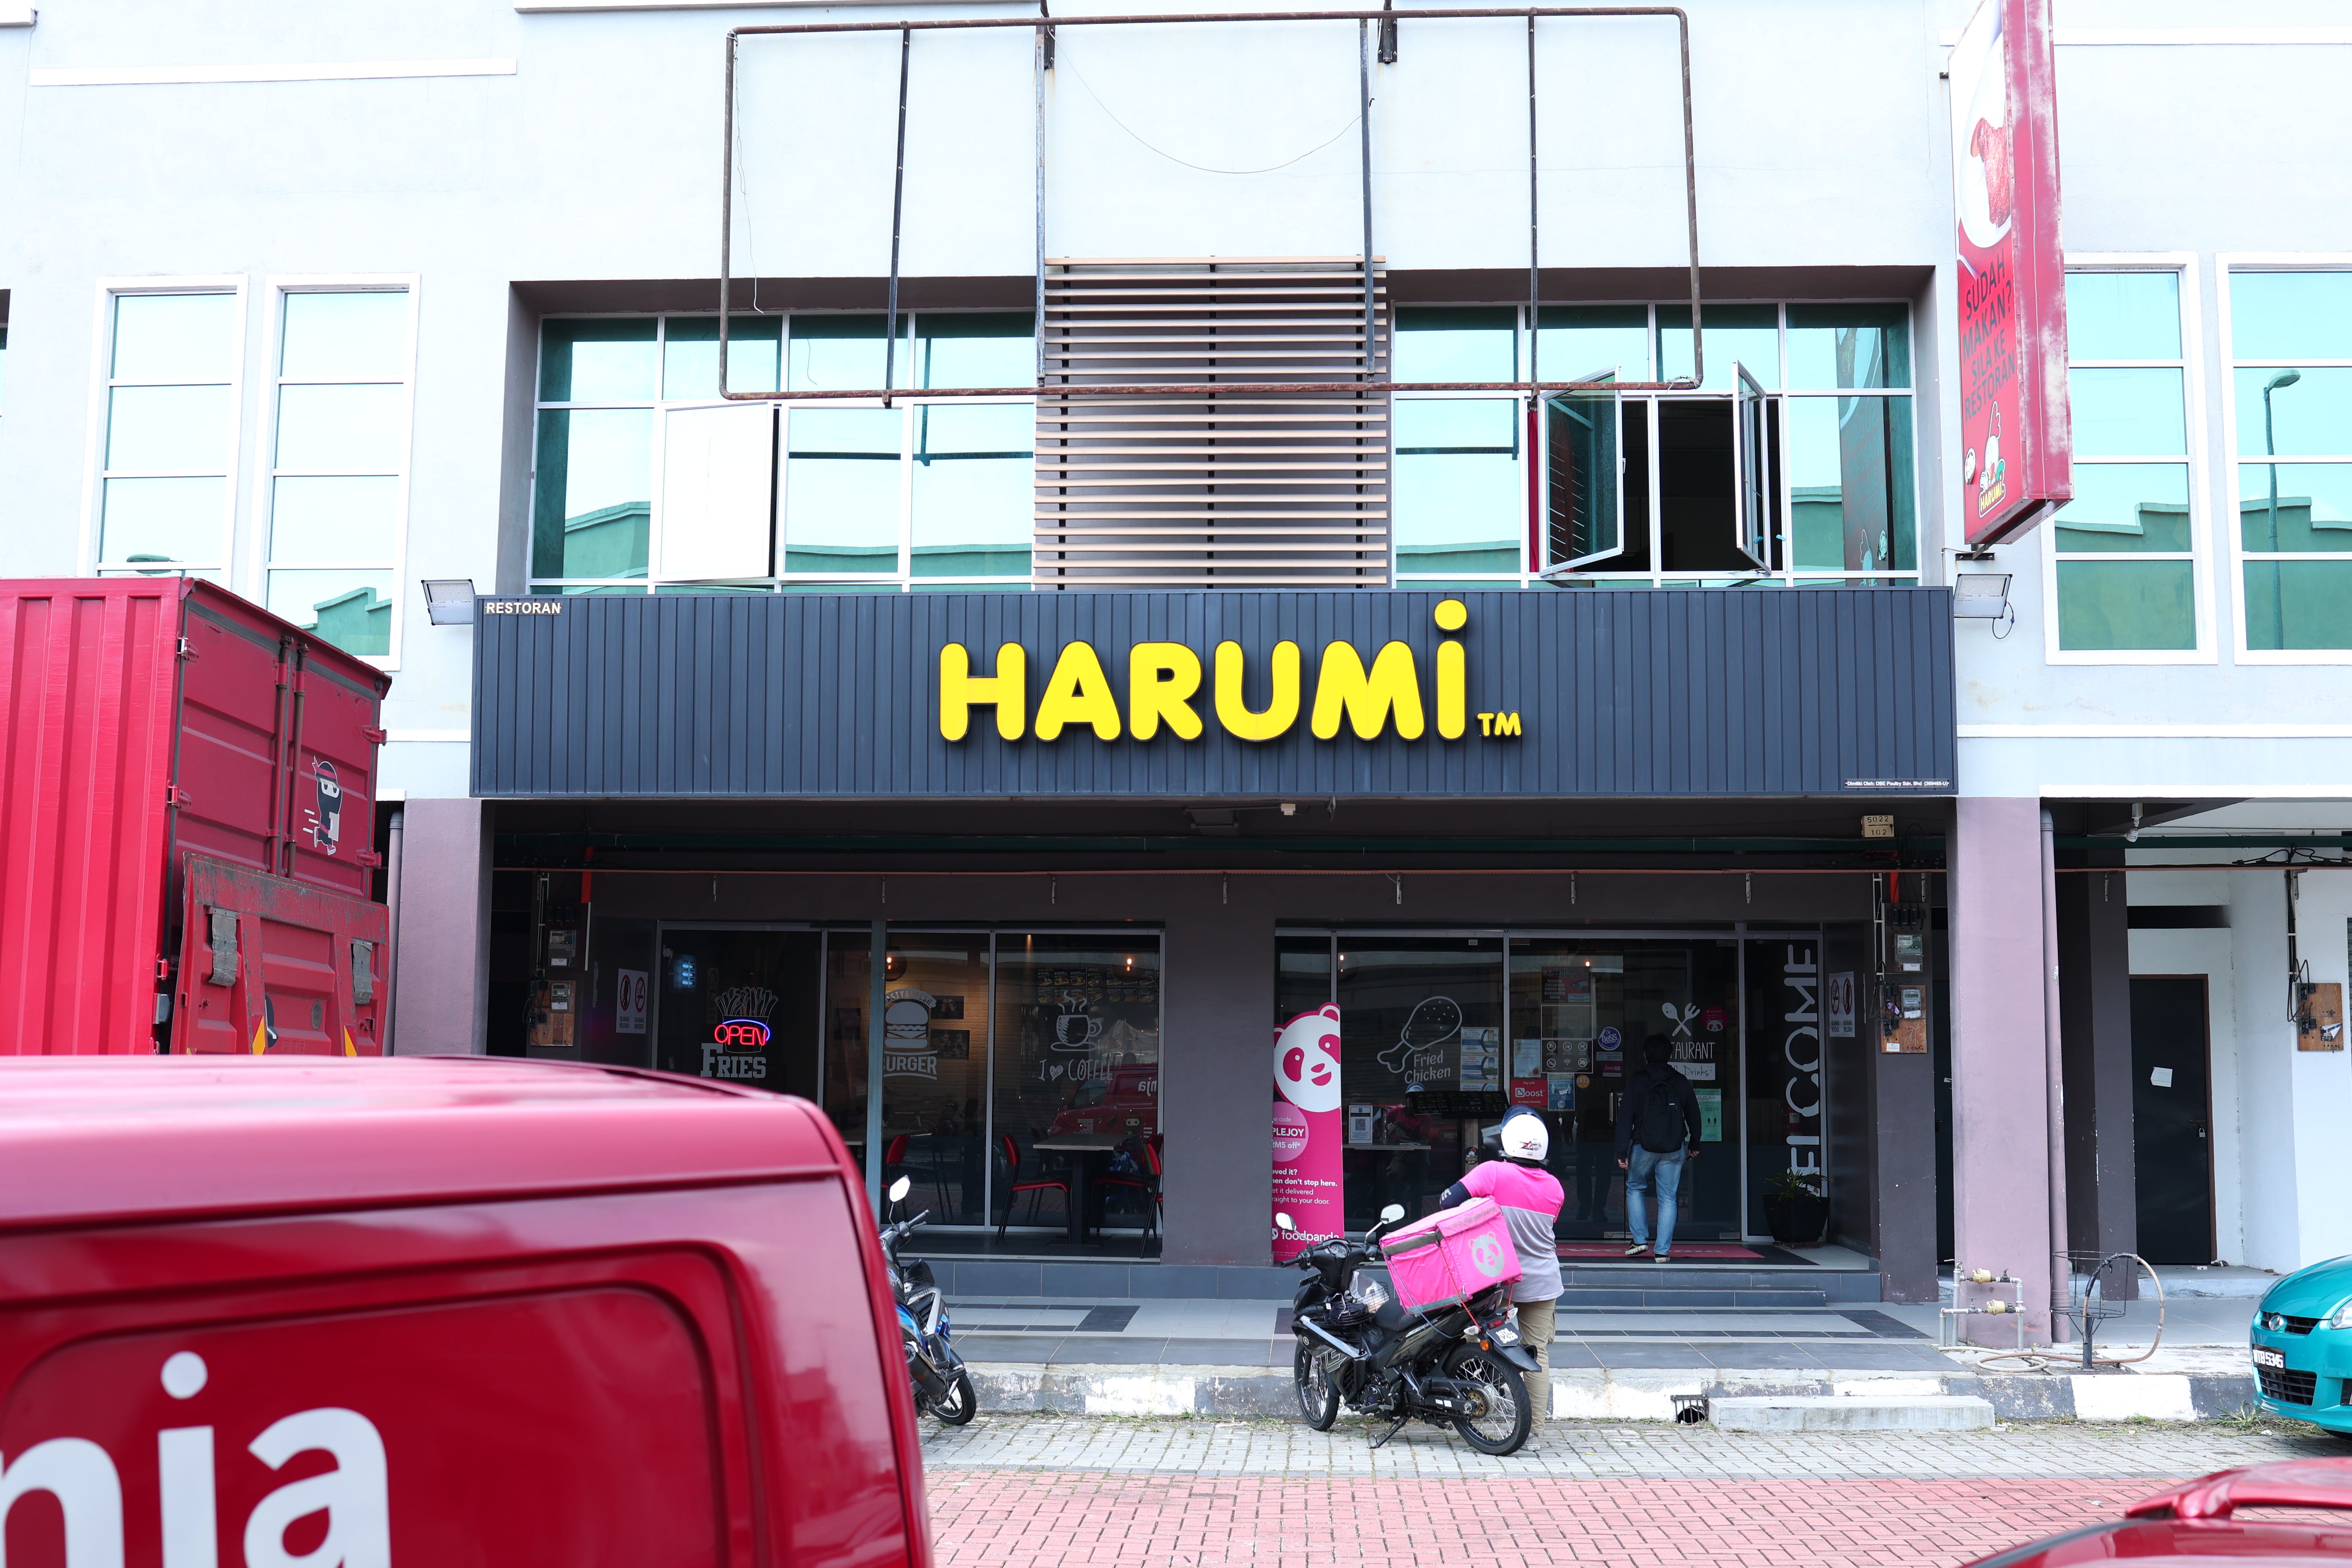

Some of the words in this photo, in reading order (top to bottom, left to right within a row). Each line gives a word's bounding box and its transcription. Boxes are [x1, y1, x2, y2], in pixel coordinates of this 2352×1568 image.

[1966, 248, 2005, 321] SUDAH
[1963, 280, 2012, 363] MAKAN?
[1972, 346, 1992, 386] SILA
[1994, 328, 2006, 363] KE
[1965, 349, 2015, 423] RESTORAN
[486, 603, 560, 613] RESTORAN
[714, 1025, 766, 1046] OPEN
[1414, 1049, 1443, 1067] Fried
[1670, 1042, 1715, 1059] TAURANT
[884, 1056, 937, 1075] URGER
[1683, 1065, 1709, 1076] Drinks
[1405, 1066, 1451, 1084] Chicken
[1515, 1087, 1544, 1097] Boost
[1495, 1328, 1513, 1338] NDL
[1500, 1332, 1518, 1344] 5628
[2265, 1352, 2284, 1369] 5345
